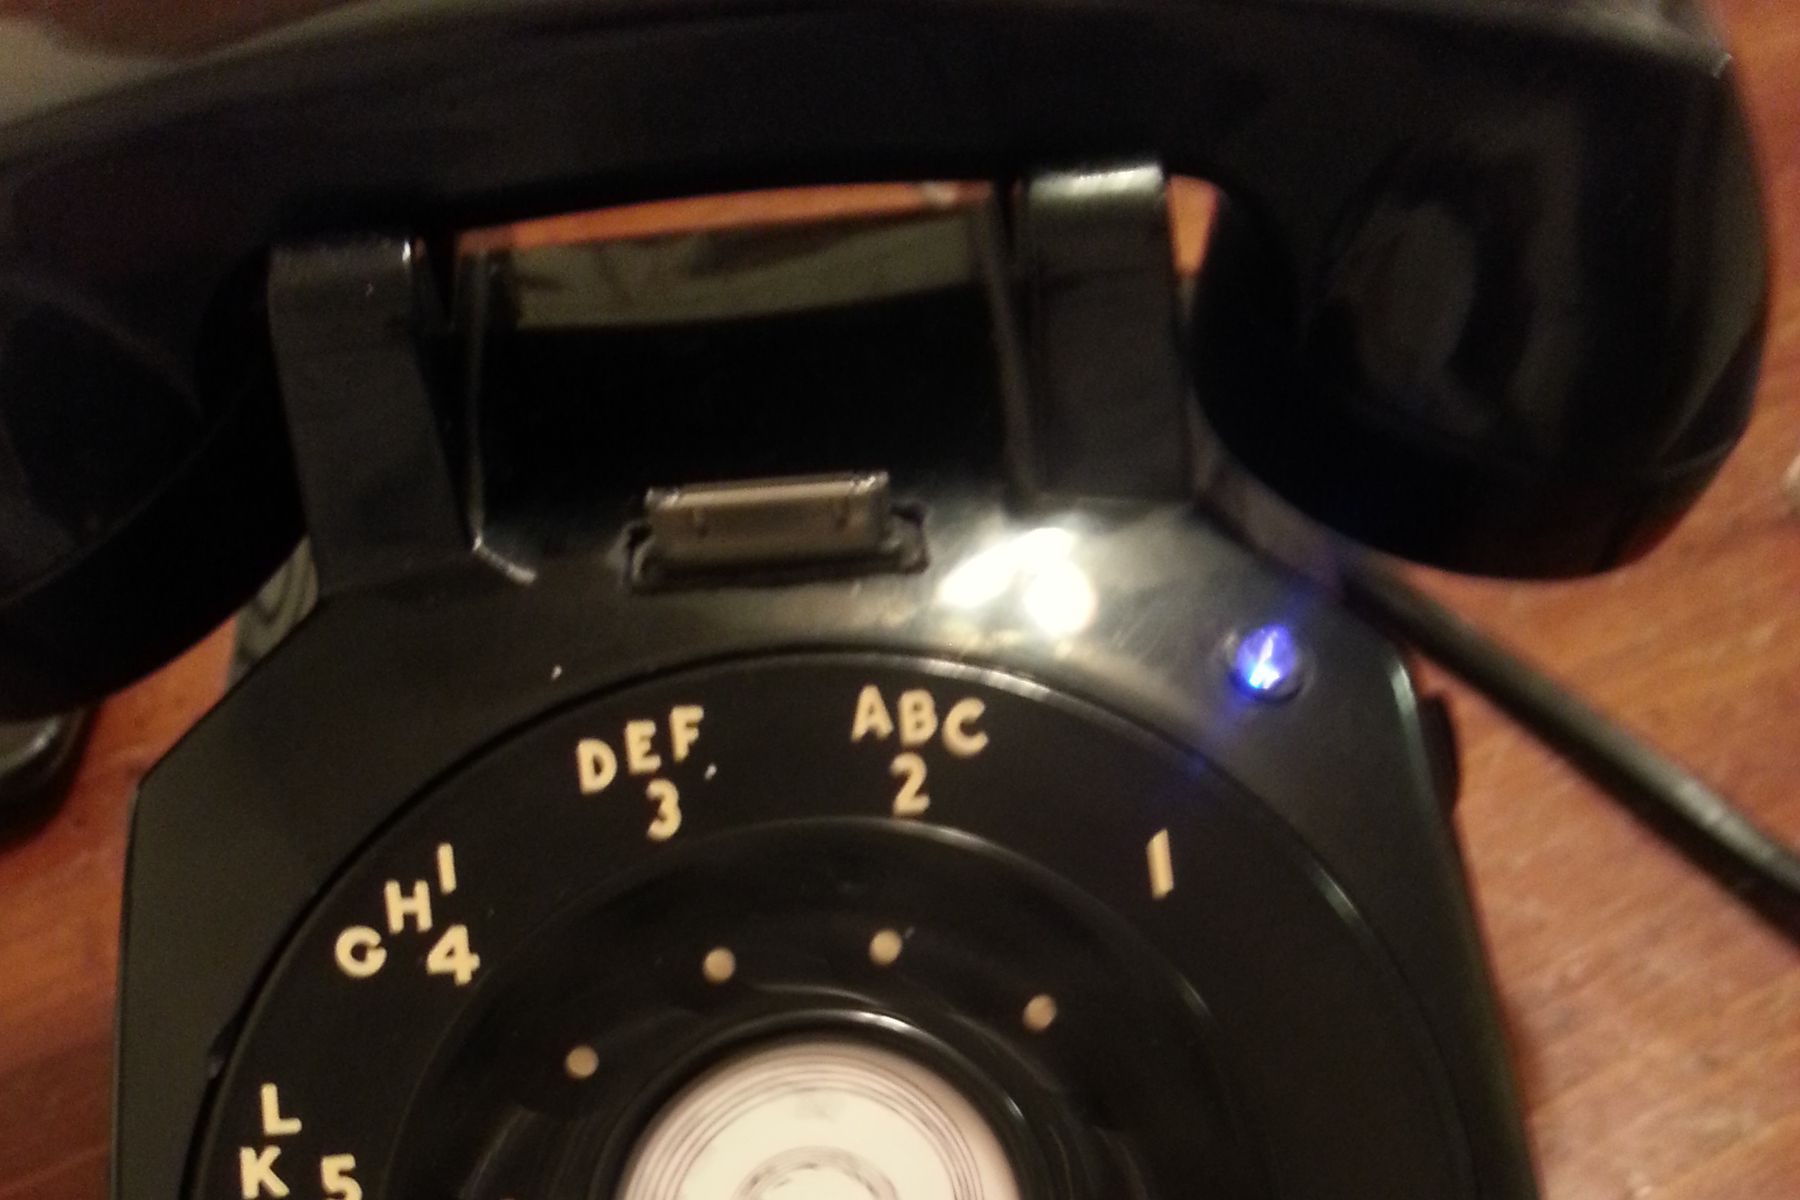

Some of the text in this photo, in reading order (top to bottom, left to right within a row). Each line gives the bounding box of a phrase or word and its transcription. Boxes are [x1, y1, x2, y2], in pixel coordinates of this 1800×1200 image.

[576, 704, 705, 793] DEF
[850, 684, 989, 756] ABC
[646, 778, 683, 840] 3
[890, 752, 930, 815] 2
[334, 842, 459, 978] GHI
[425, 924, 481, 985] 4
